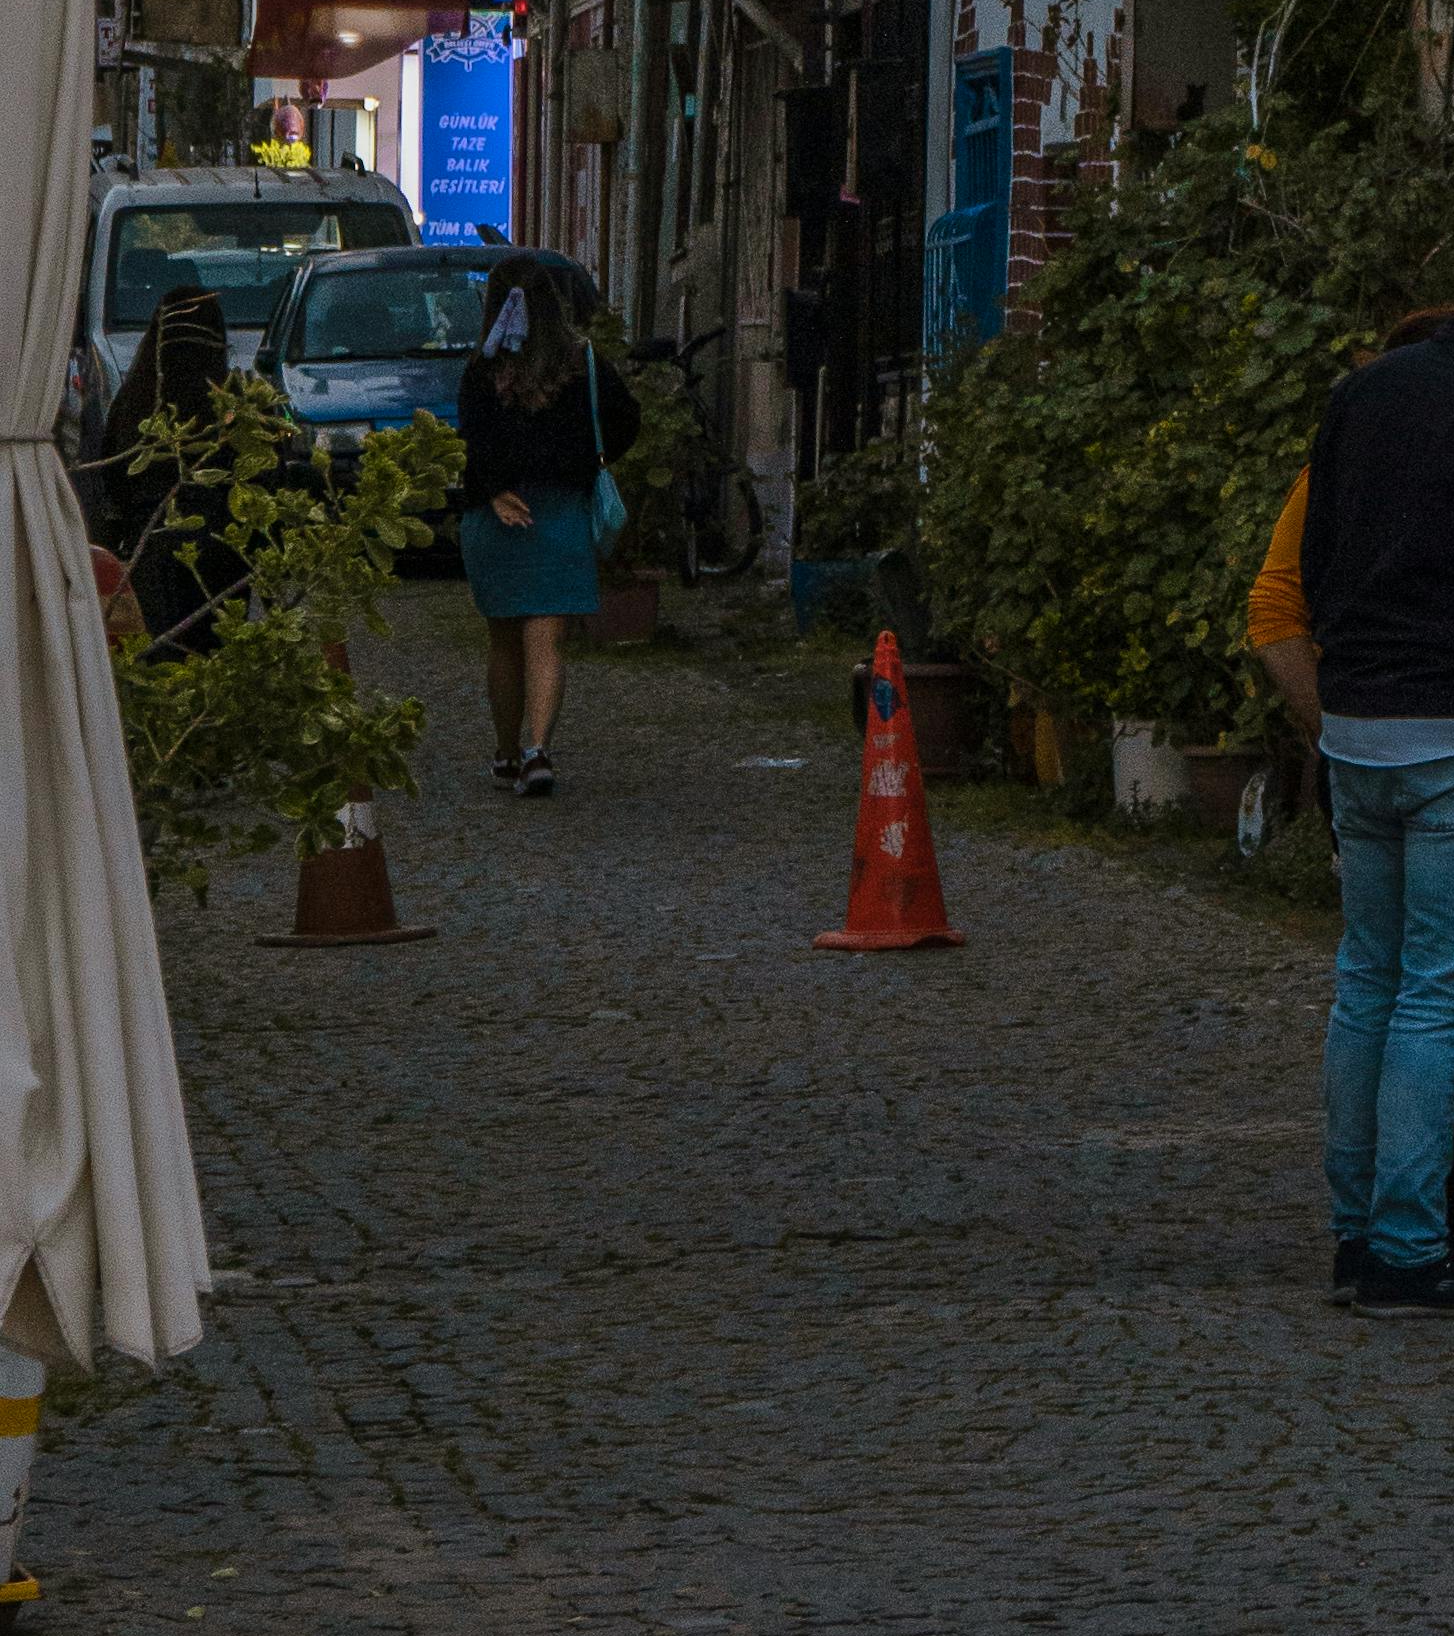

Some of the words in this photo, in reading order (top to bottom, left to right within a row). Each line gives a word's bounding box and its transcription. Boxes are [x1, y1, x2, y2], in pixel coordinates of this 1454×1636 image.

[439, 112, 499, 131] GÜNLÜK
[452, 136, 487, 152] TAZE
[446, 157, 490, 173] BALIK
[430, 177, 506, 197] ÇEŞİTLERİ
[428, 218, 461, 237] TÜM
